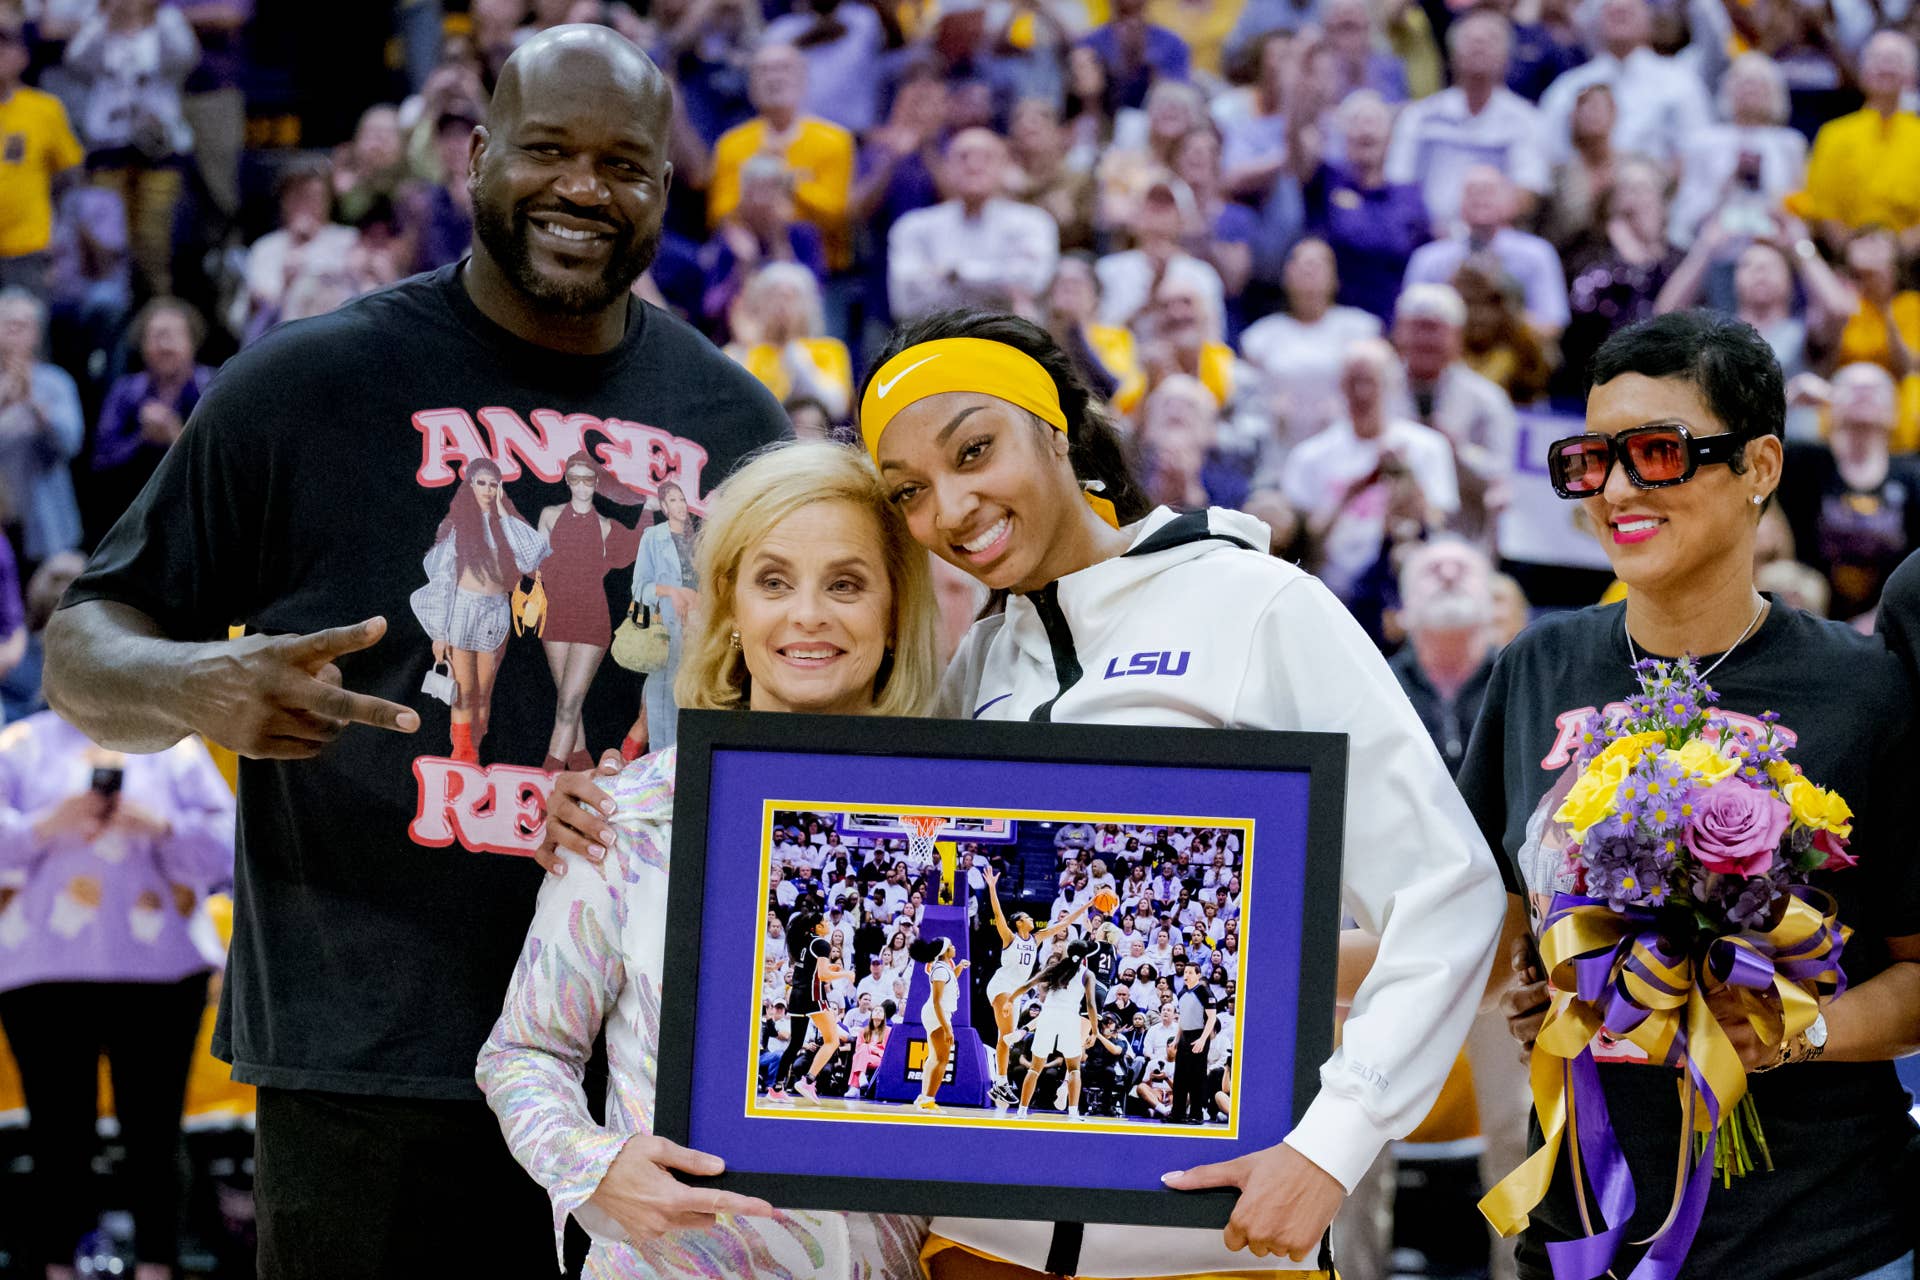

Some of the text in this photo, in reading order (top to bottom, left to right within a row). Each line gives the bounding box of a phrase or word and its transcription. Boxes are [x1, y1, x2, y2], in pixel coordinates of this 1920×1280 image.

[411, 406, 709, 517] ANGEL
[1103, 651, 1191, 680] LSU
[408, 755, 558, 857] RE
[1016, 943, 1035, 951] LSU
[1019, 952, 1031, 966] 10
[1098, 953, 1111, 970] 21
